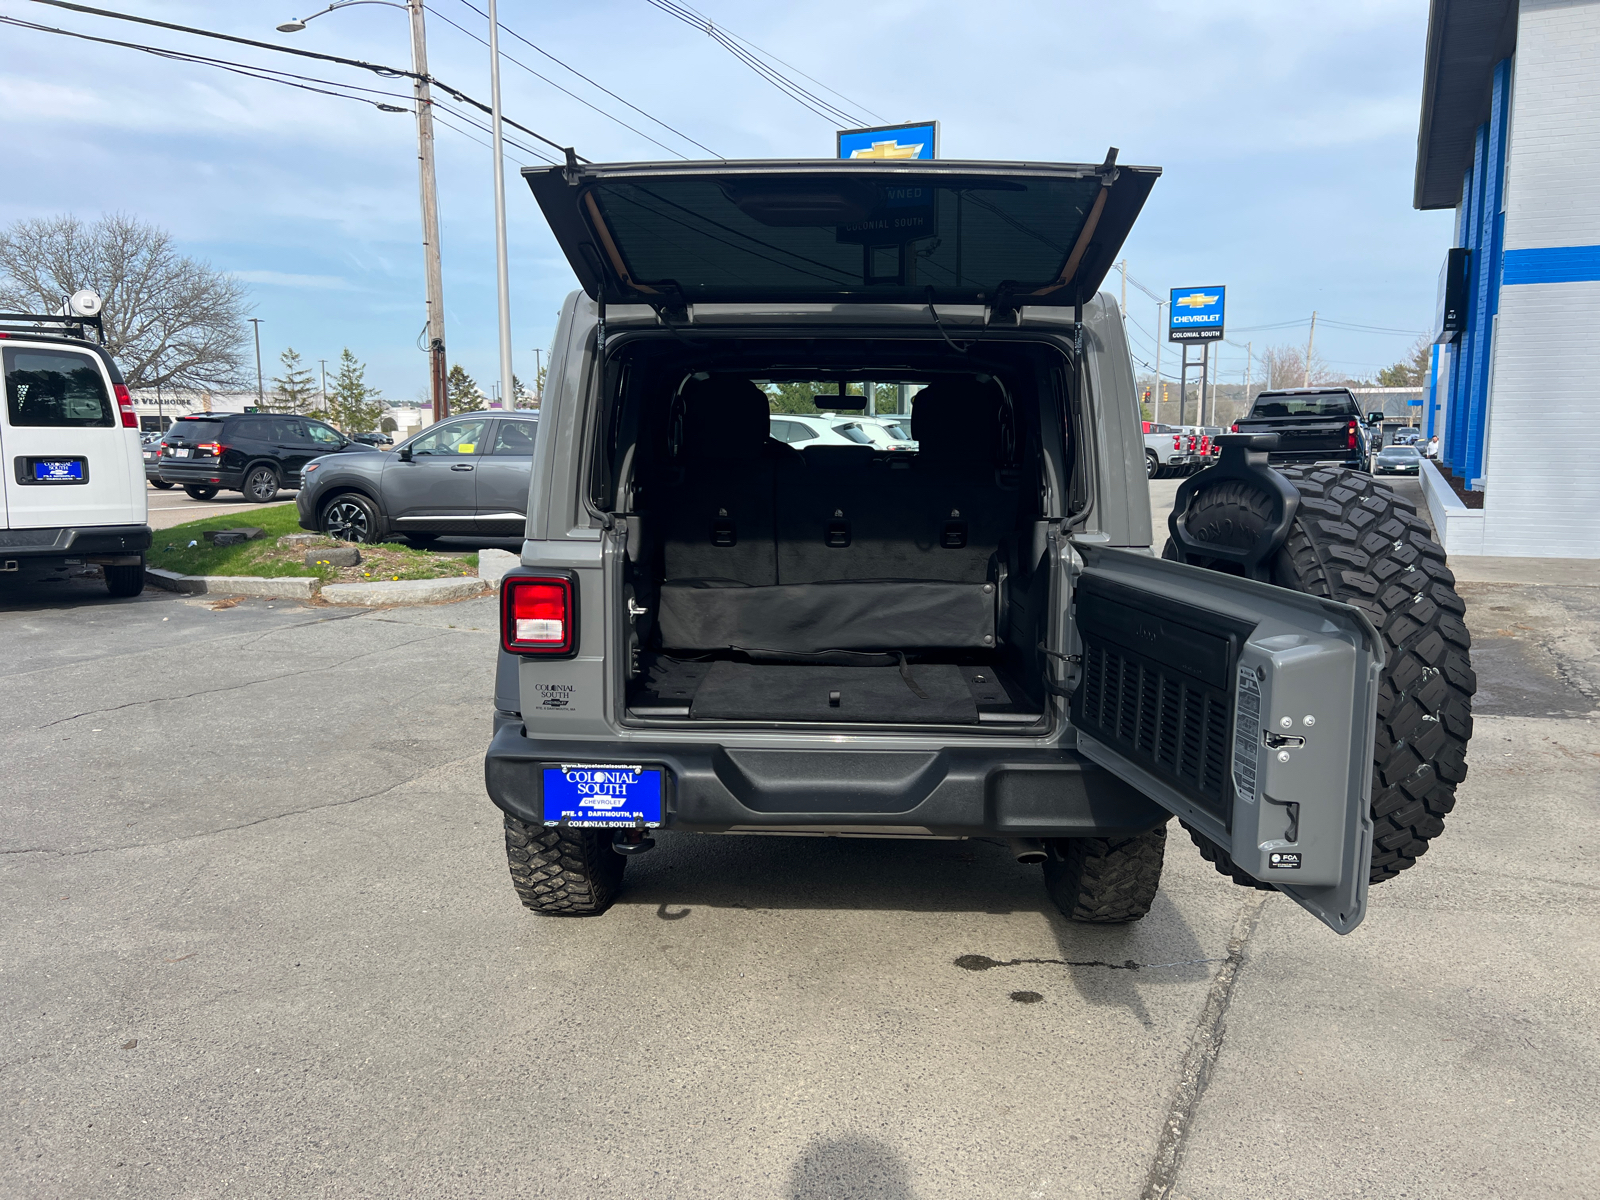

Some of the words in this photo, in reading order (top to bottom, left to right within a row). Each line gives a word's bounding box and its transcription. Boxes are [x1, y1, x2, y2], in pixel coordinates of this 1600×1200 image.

[846, 219, 889, 231] COLONIAL
[894, 217, 924, 228] SOUTH
[1173, 314, 1220, 323] CHEVROLET
[535, 684, 576, 692] COLONIAL
[566, 771, 638, 784] COLONIAL
[577, 783, 627, 795] SOUTH
